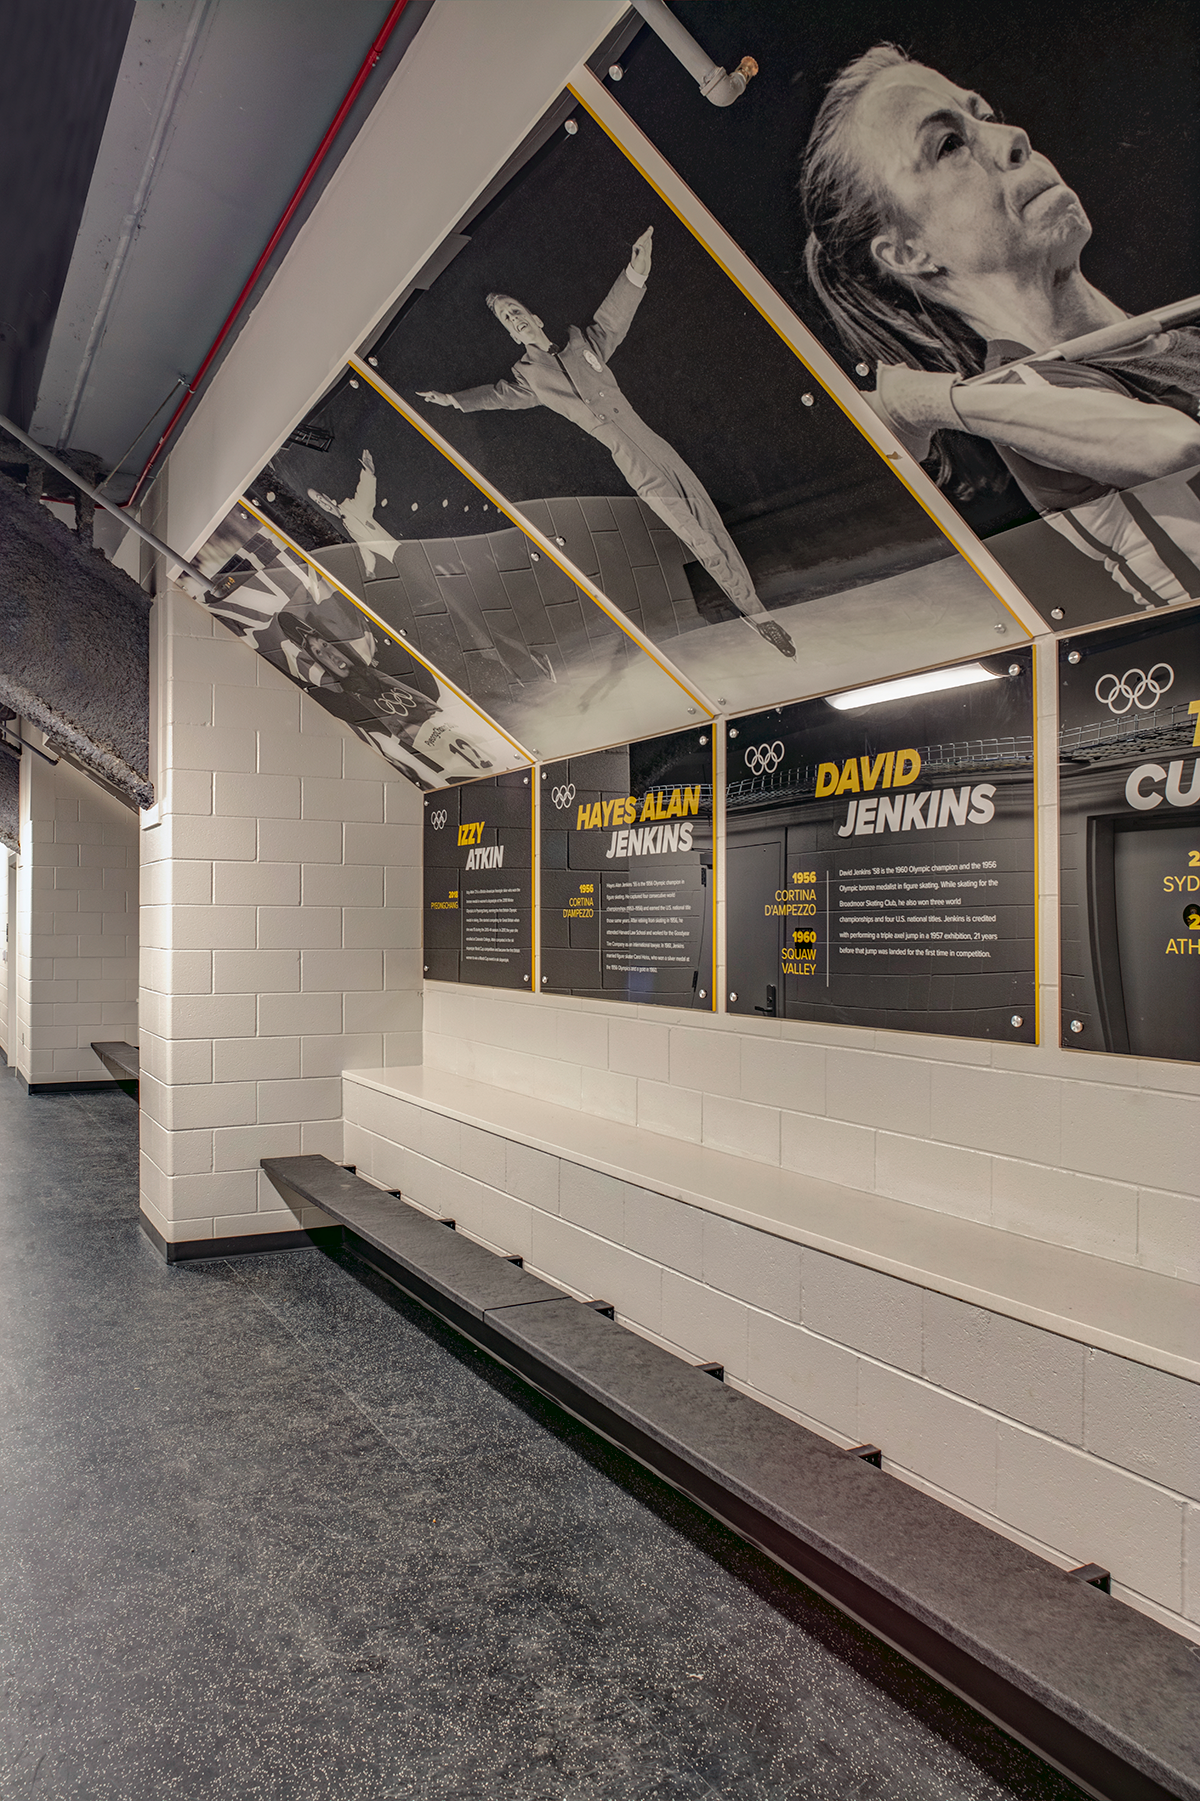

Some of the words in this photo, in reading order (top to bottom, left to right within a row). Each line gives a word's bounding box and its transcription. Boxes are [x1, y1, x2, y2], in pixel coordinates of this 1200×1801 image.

[449, 738, 493, 769] 12
[815, 748, 921, 798] DAVID
[576, 795, 637, 831] HAYES
[639, 785, 701, 823] ALAN
[837, 783, 997, 838] JENKINS
[457, 821, 486, 847] IZZY
[605, 822, 694, 859] JENKINS
[465, 845, 505, 871] ATKIN
[839, 869, 853, 877] David
[853, 868, 871, 876] Jenkins
[872, 867, 880, 875] '58
[881, 867, 885, 875] is
[895, 865, 908, 874] 1960
[909, 864, 930, 874] Olympic
[931, 863, 958, 873] champion
[959, 862, 970, 870] and
[971, 862, 981, 870] the
[982, 860, 997, 869] 1956
[792, 871, 817, 884] 1956
[579, 883, 594, 894] 1956
[839, 884, 858, 893] Olympic
[876, 883, 897, 891] medalist
[898, 882, 902, 890] in
[903, 882, 918, 891] figure
[919, 881, 940, 890] skating.
[940, 880, 956, 888] While
[957, 879, 978, 889] skating
[978, 878, 987, 887] for
[988, 878, 999, 887] the
[568, 897, 595, 907] CORTINA
[774, 888, 817, 902] CORTINA
[764, 903, 817, 916] D'AMPEZZO
[866, 899, 884, 908] Skating
[884, 899, 898, 907] Club,
[930, 898, 945, 906] three
[945, 897, 962, 905] world
[562, 908, 595, 918] D'AMPEZZO
[839, 915, 874, 924] championships
[874, 915, 884, 923] and
[885, 915, 895, 923] four
[895, 915, 906, 923] U.S.
[907, 915, 927, 923] national
[928, 915, 942, 923] titles.
[943, 914, 965, 923] Jenkins
[966, 914, 971, 922] is
[972, 914, 997, 922] credited
[792, 930, 817, 944] 1960
[839, 931, 849, 939] with
[850, 931, 876, 940] performing
[880, 931, 893, 940] triple
[894, 931, 905, 939] axel
[905, 931, 919, 940] jump
[919, 931, 925, 939] in
[930, 931, 943, 939] 1957
[943, 932, 973, 940] exhibition,
[973, 932, 980, 940] 21
[981, 933, 998, 941] years
[781, 947, 817, 961] SQUAW
[839, 946, 854, 954] before
[855, 947, 865, 955] that
[865, 947, 877, 956] jump
[889, 947, 906, 955] landed
[907, 948, 915, 956] for
[915, 948, 925, 956] the
[925, 949, 936, 957] first
[936, 949, 948, 957] time
[949, 949, 955, 957] in
[955, 950, 991, 958] competition.
[781, 962, 817, 976] VALLEY
